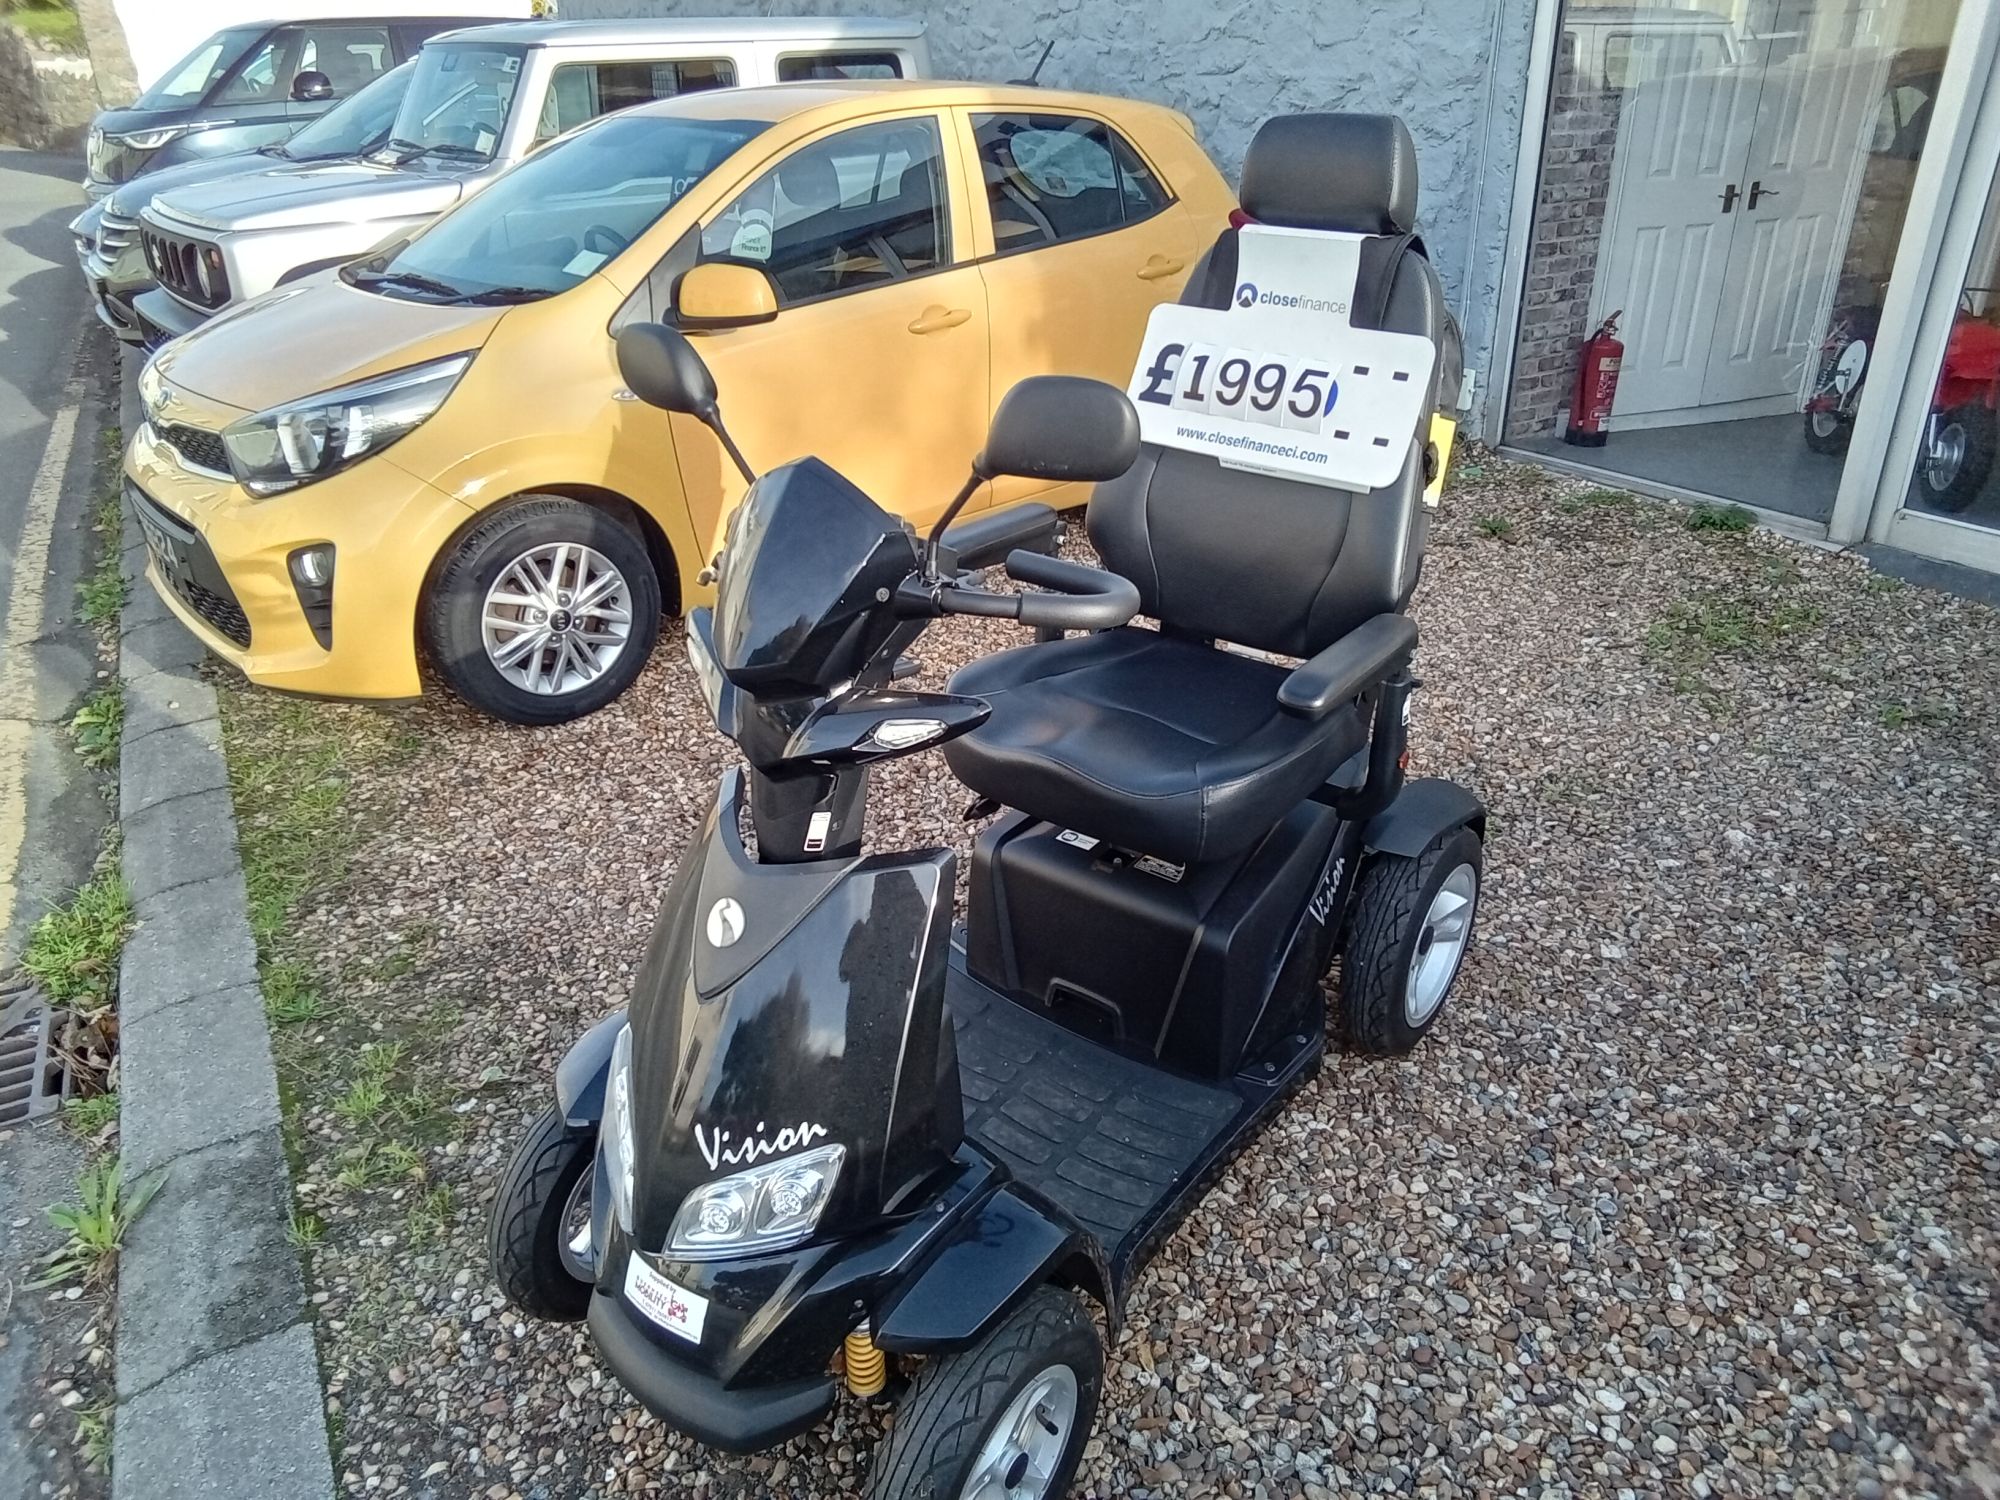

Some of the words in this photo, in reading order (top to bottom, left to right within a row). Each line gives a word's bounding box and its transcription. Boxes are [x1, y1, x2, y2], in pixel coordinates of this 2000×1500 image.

[1259, 290, 1347, 314] closefinance
[1176, 425, 1328, 465] www.closefinanceci.com
[1309, 857, 1345, 927] Vision
[694, 1121, 828, 1171] Vision
[635, 1279, 667, 1310] MOBILITY
